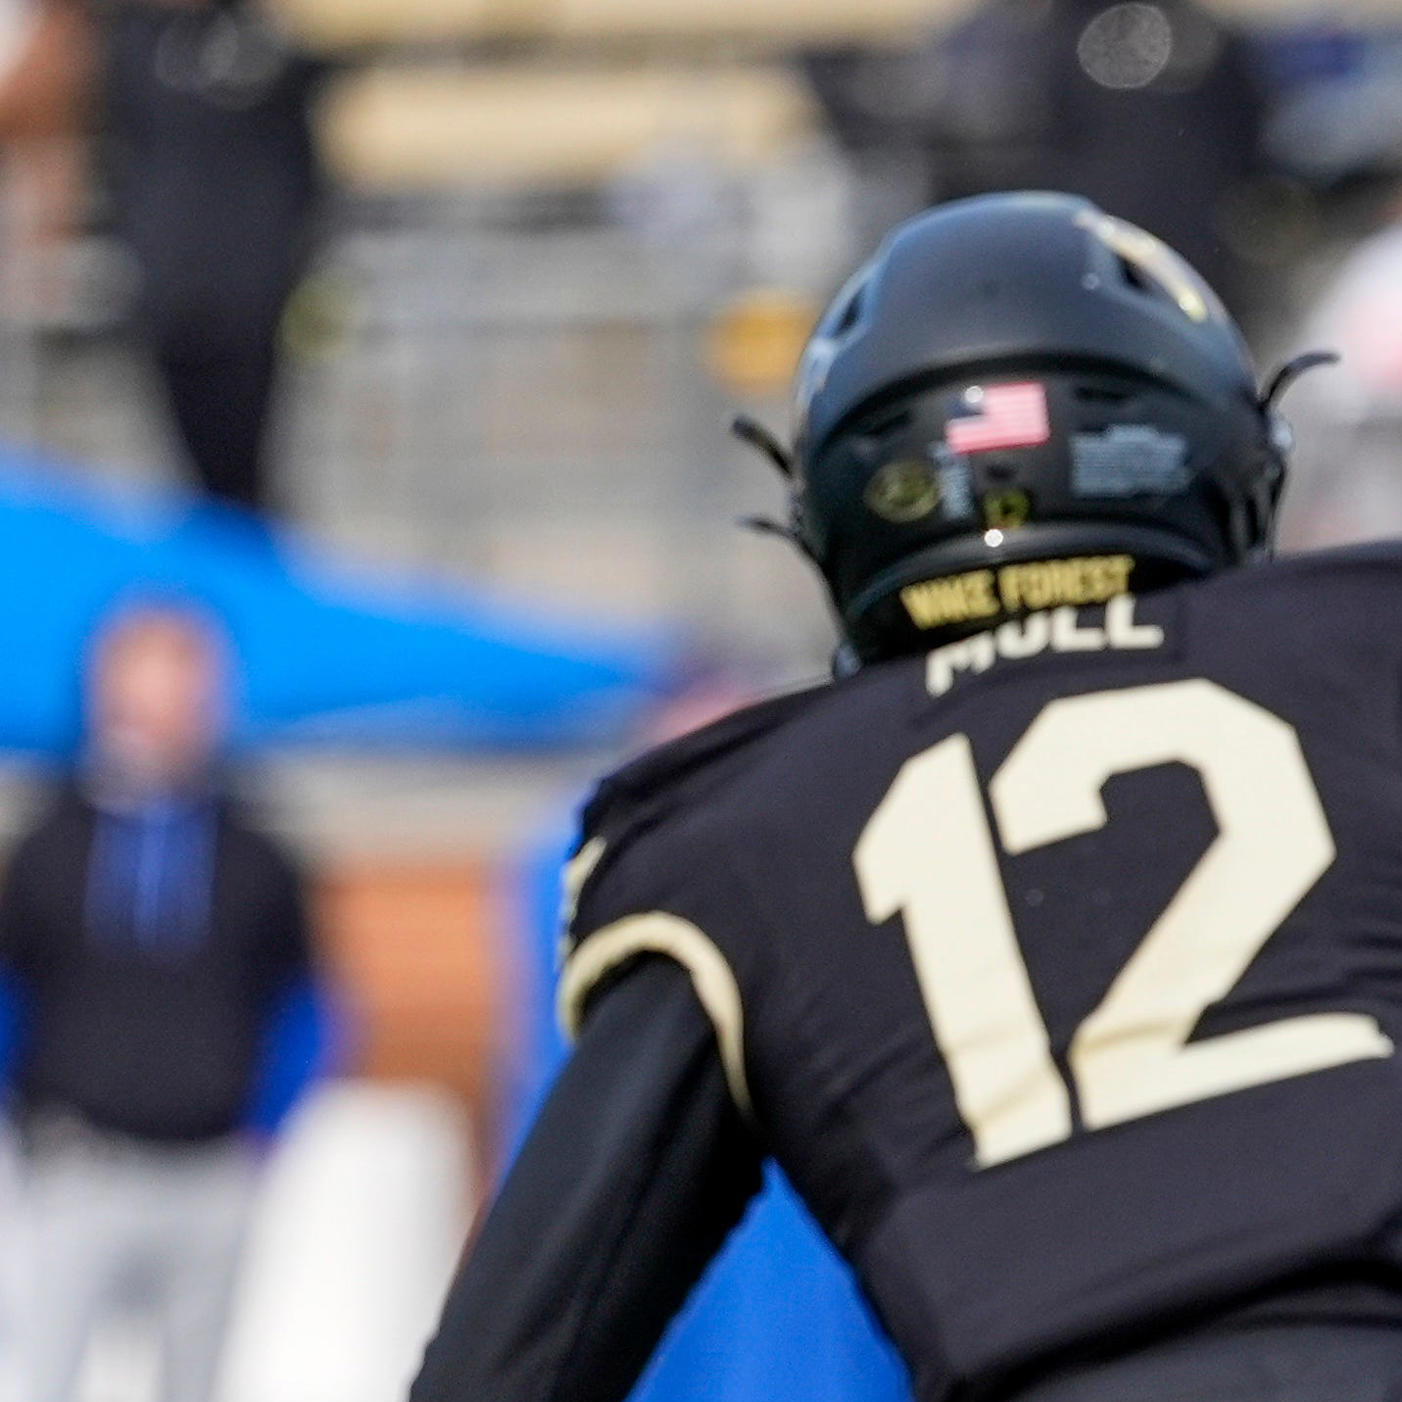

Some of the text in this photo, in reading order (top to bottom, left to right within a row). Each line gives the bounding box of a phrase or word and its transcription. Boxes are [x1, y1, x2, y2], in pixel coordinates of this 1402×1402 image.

[901, 553, 1136, 631] WAKE FOREST
[852, 676, 1395, 1171] 12
